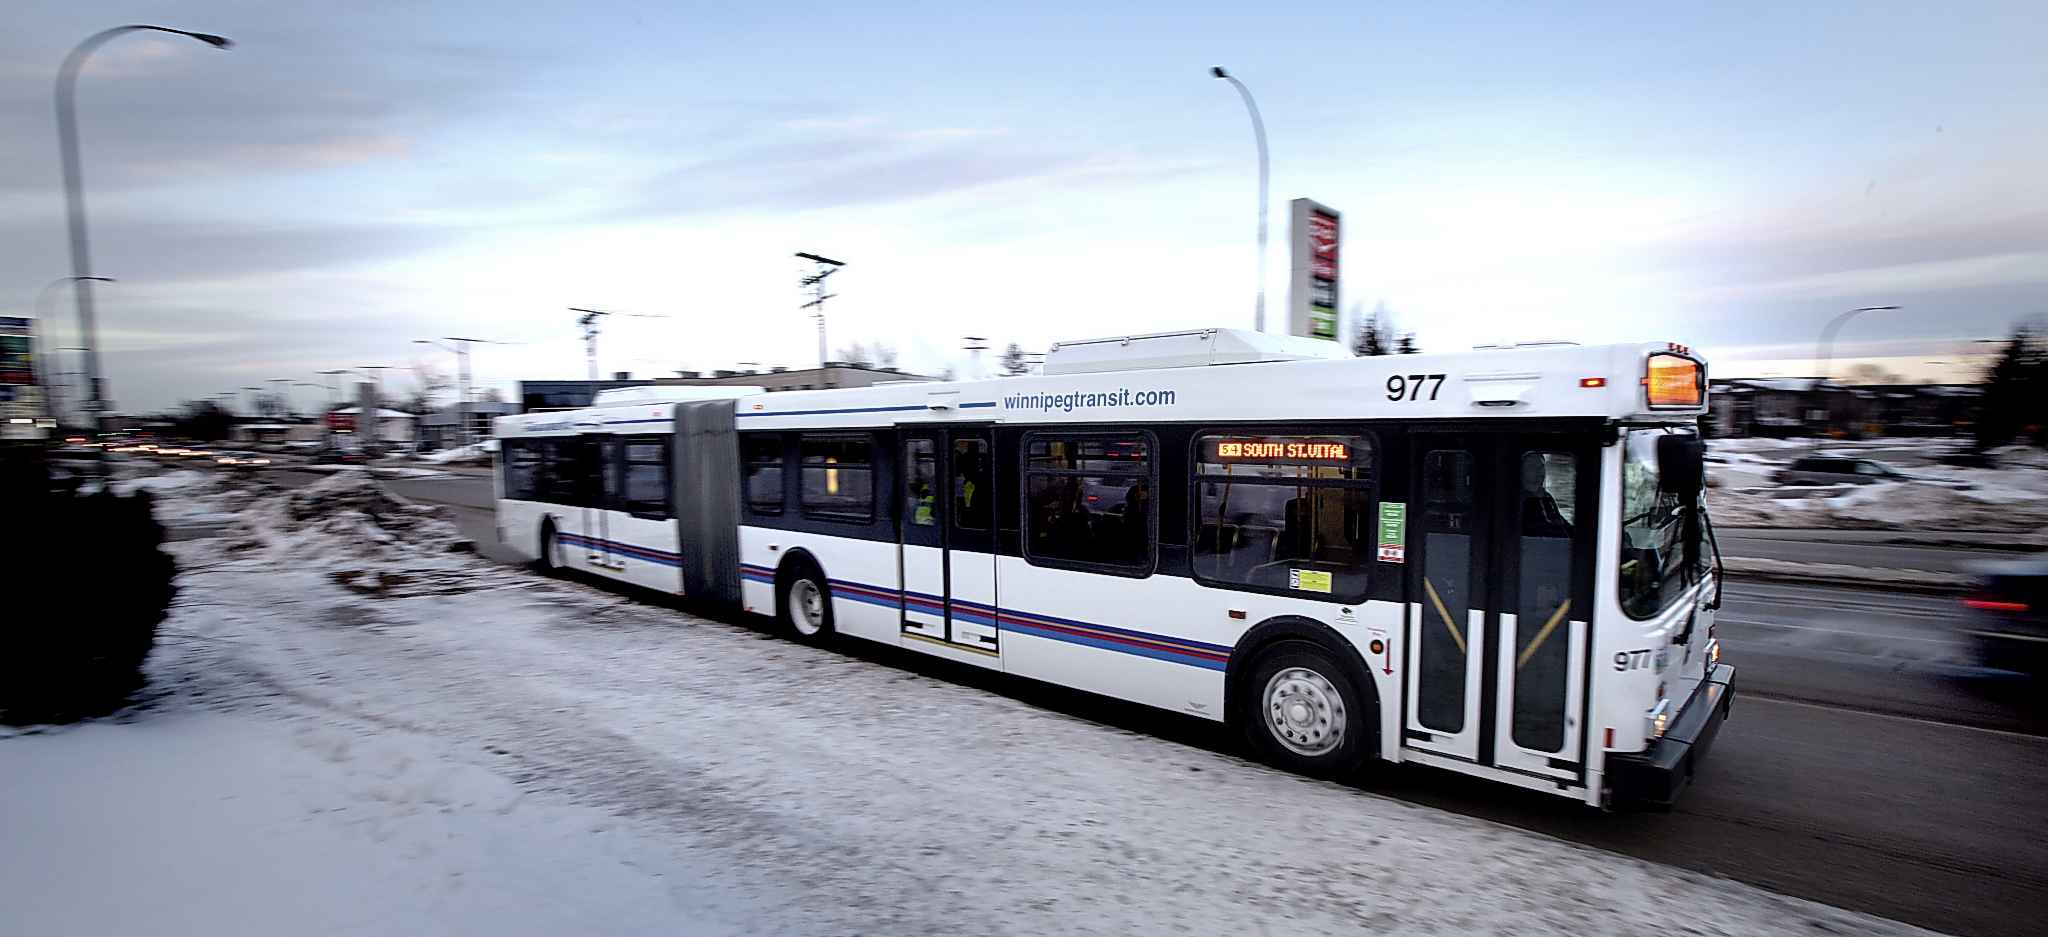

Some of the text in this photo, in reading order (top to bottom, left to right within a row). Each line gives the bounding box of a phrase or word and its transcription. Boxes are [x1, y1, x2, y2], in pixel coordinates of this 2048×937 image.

[1003, 387, 1176, 412] winnipegtransit.com
[1385, 374, 1447, 401] 977
[1243, 443, 1284, 457] SOUTH
[1614, 649, 1651, 672] 977
